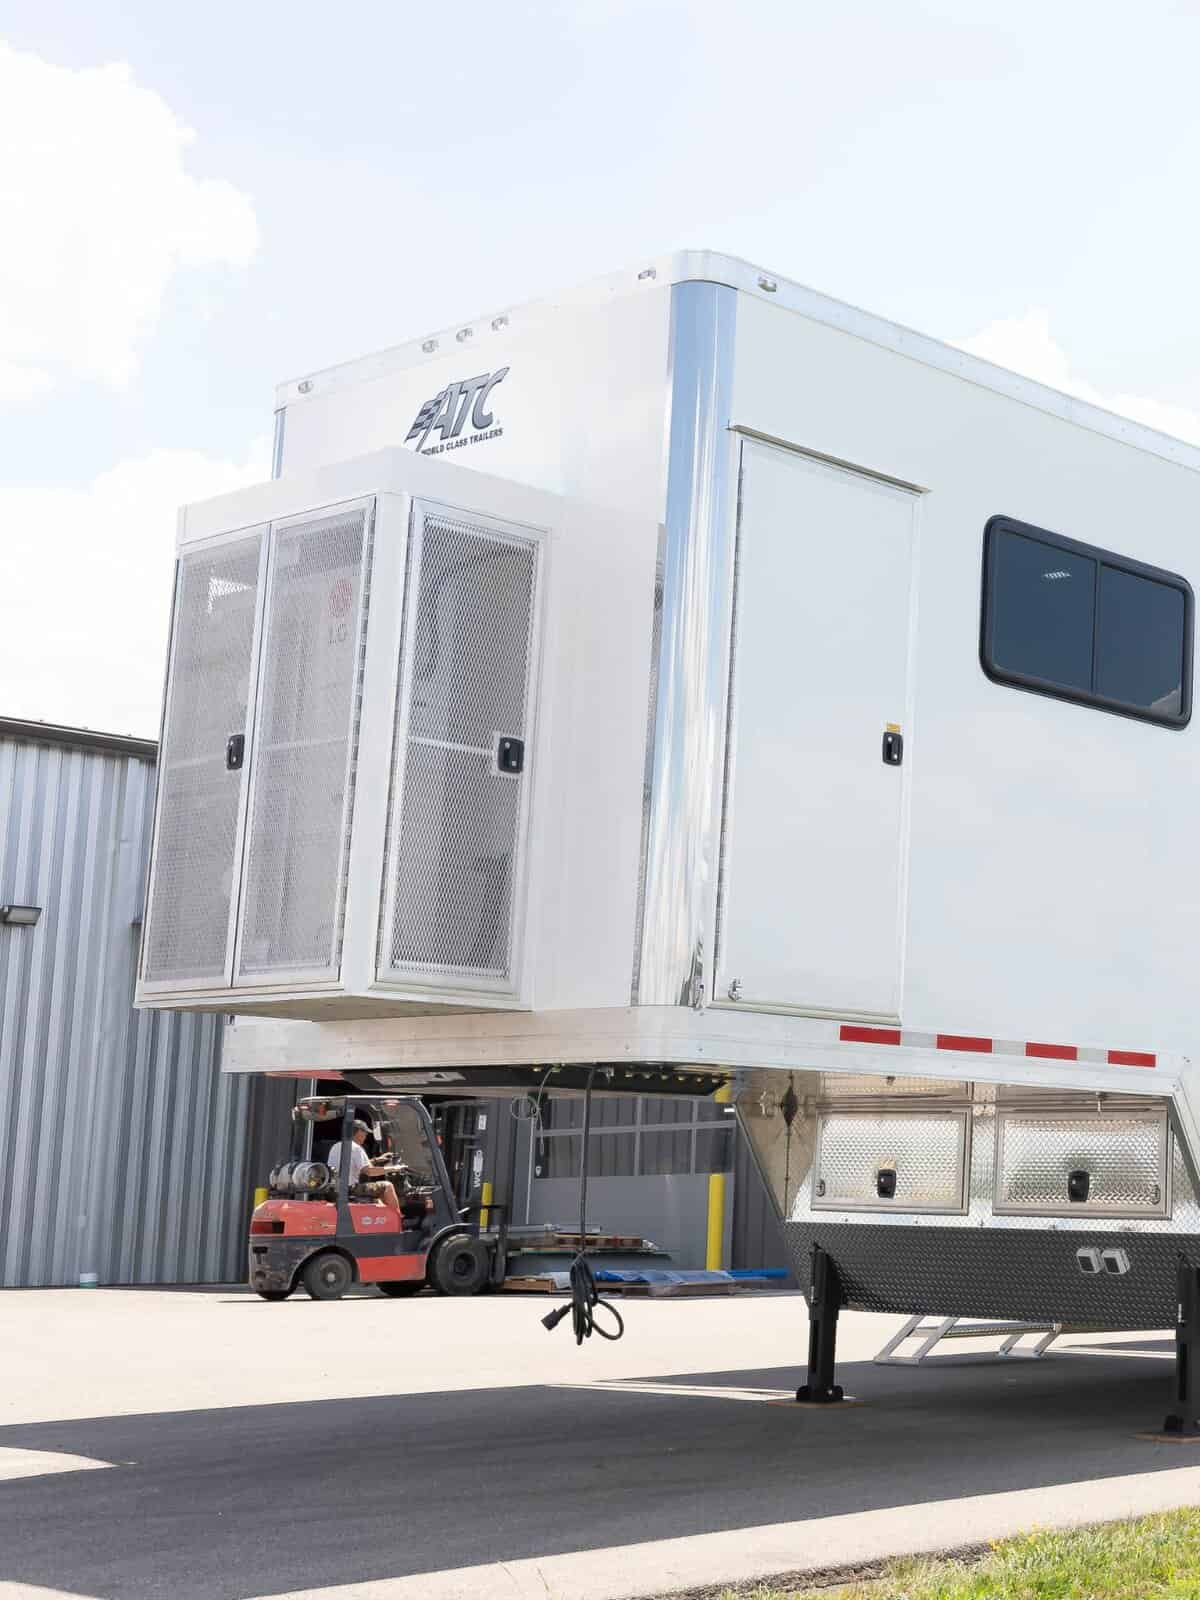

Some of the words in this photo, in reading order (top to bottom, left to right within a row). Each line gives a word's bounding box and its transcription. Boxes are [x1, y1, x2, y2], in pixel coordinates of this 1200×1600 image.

[404, 366, 511, 453] ATC
[446, 438, 468, 452] CLASS
[470, 428, 504, 445] TRAILERS
